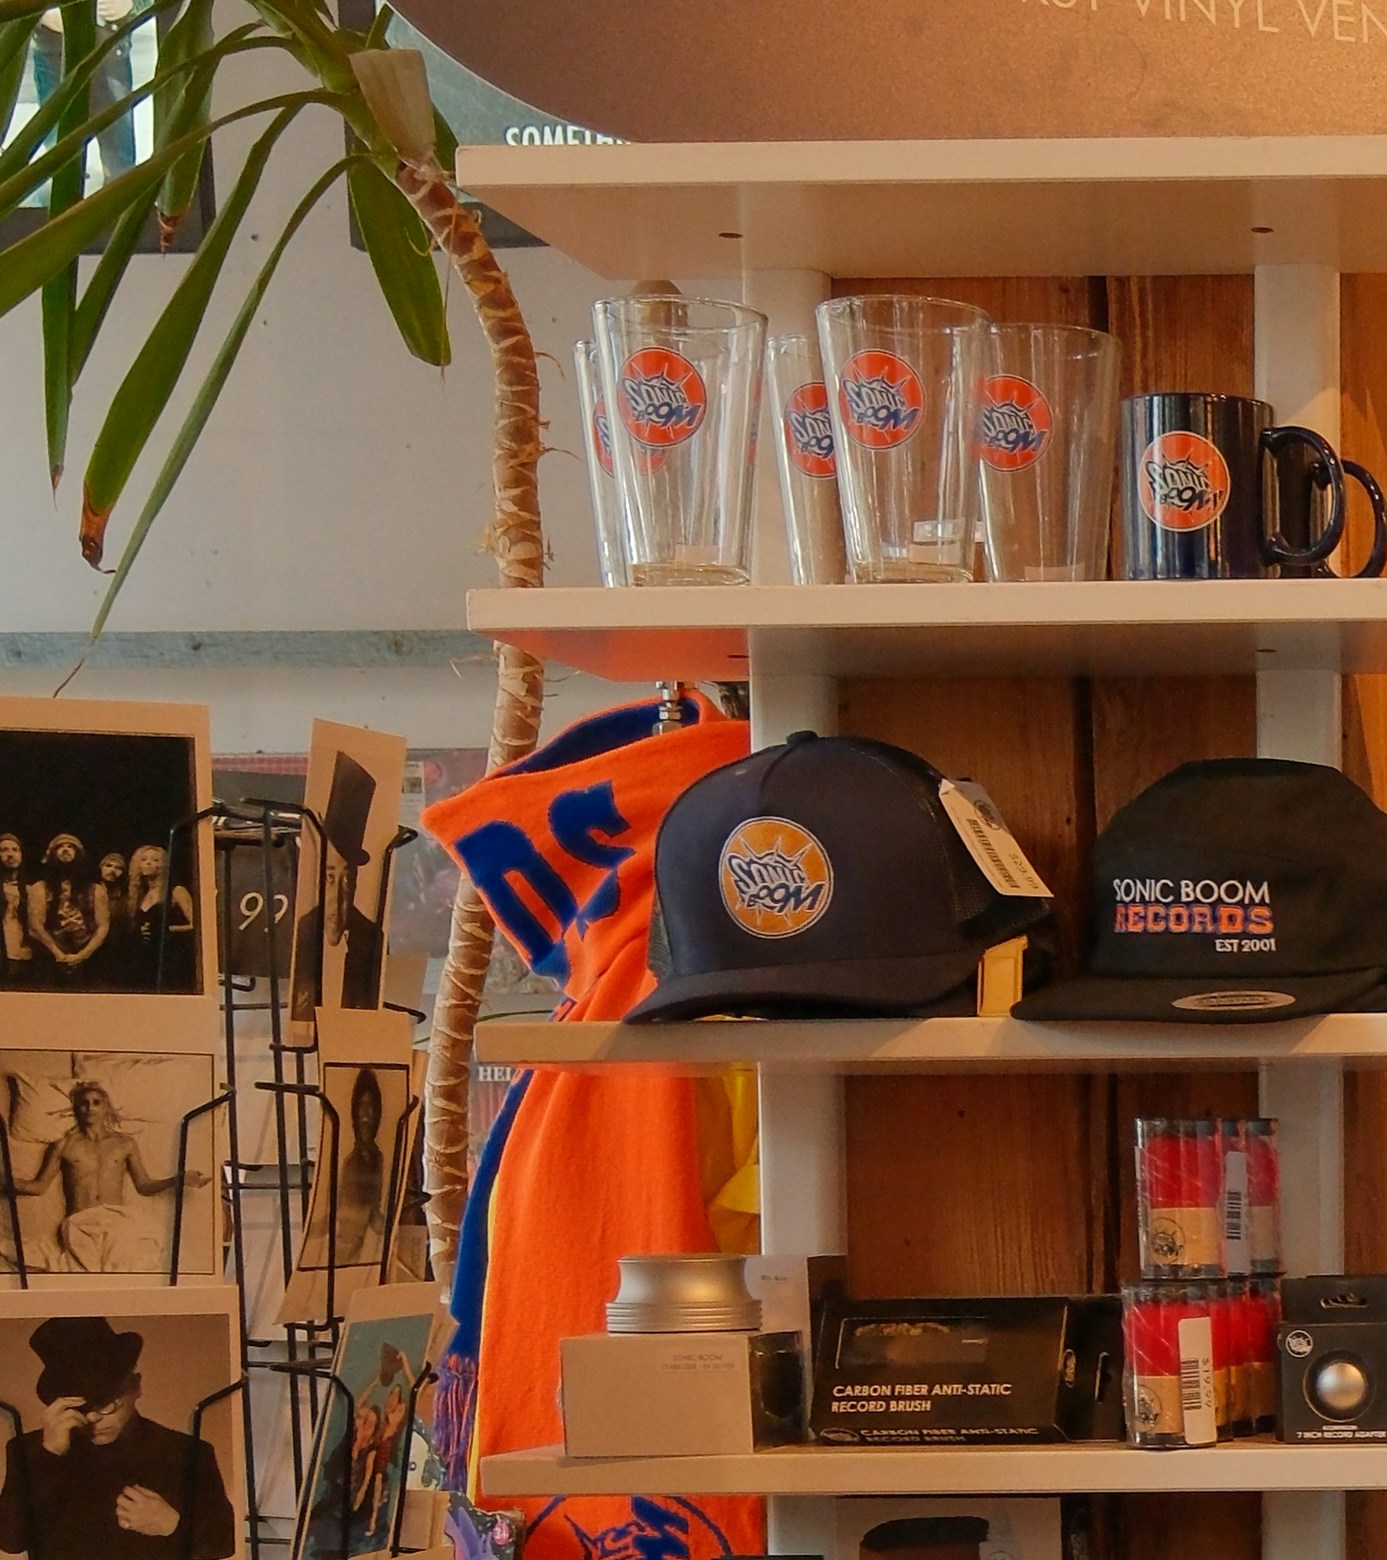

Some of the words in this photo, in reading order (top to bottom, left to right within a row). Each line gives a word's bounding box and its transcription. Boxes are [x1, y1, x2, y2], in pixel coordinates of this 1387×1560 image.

[727, 854, 808, 893] SONIC
[747, 881, 826, 914] BOOM
[1113, 879, 1174, 902] SONIC
[1180, 880, 1270, 904] BOOM
[1114, 904, 1274, 934] RECORDS
[1215, 939, 1238, 952] EST
[1241, 938, 1276, 952] 2001
[833, 1384, 891, 1397] CARBON
[894, 1383, 928, 1396] FIBER
[931, 1383, 1012, 1395] ANTI-STATIC
[831, 1400, 886, 1413] RECORD
[890, 1400, 931, 1412] BRUSH
